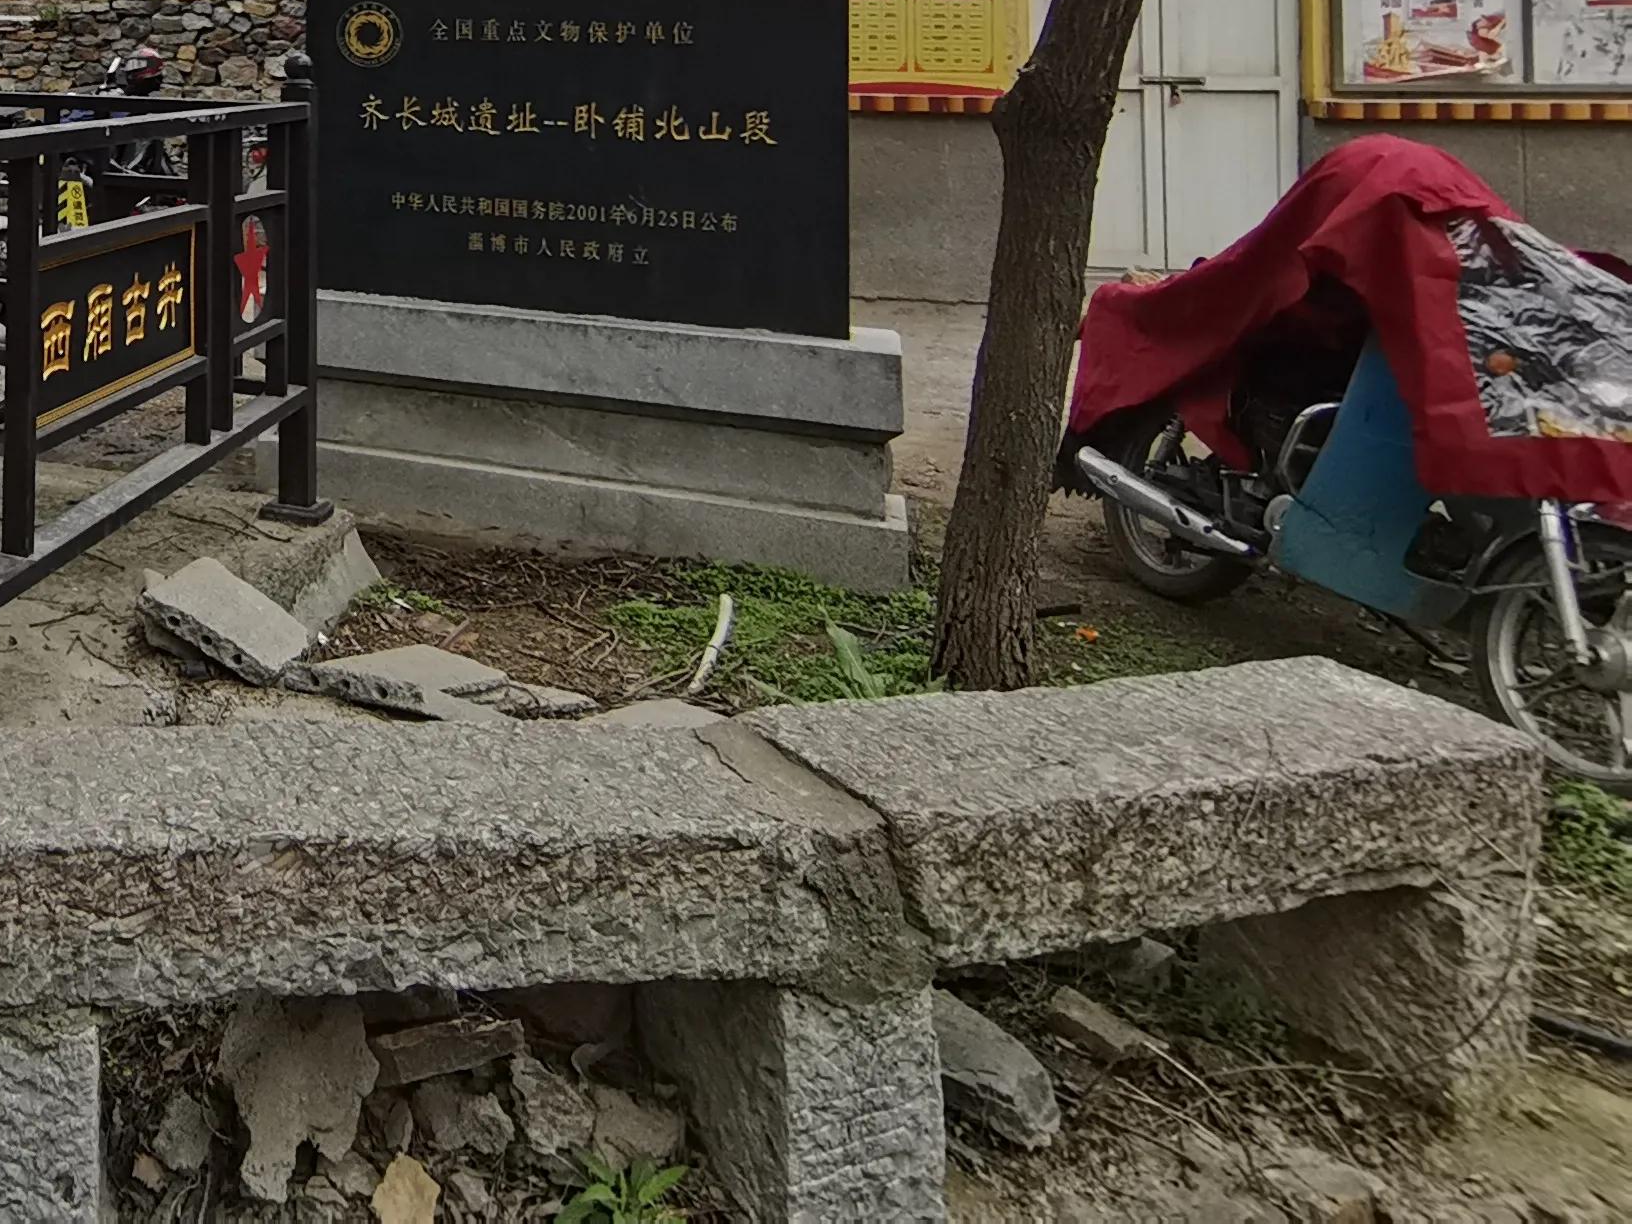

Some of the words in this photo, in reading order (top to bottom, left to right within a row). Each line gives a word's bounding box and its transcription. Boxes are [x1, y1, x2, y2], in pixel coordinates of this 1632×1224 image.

[429, 17, 695, 47] 全国重点文物保护单位
[390, 191, 740, 234] 中华人民共和国国务院2001年6月25日公布
[467, 231, 651, 267] 淄博市人民政府立
